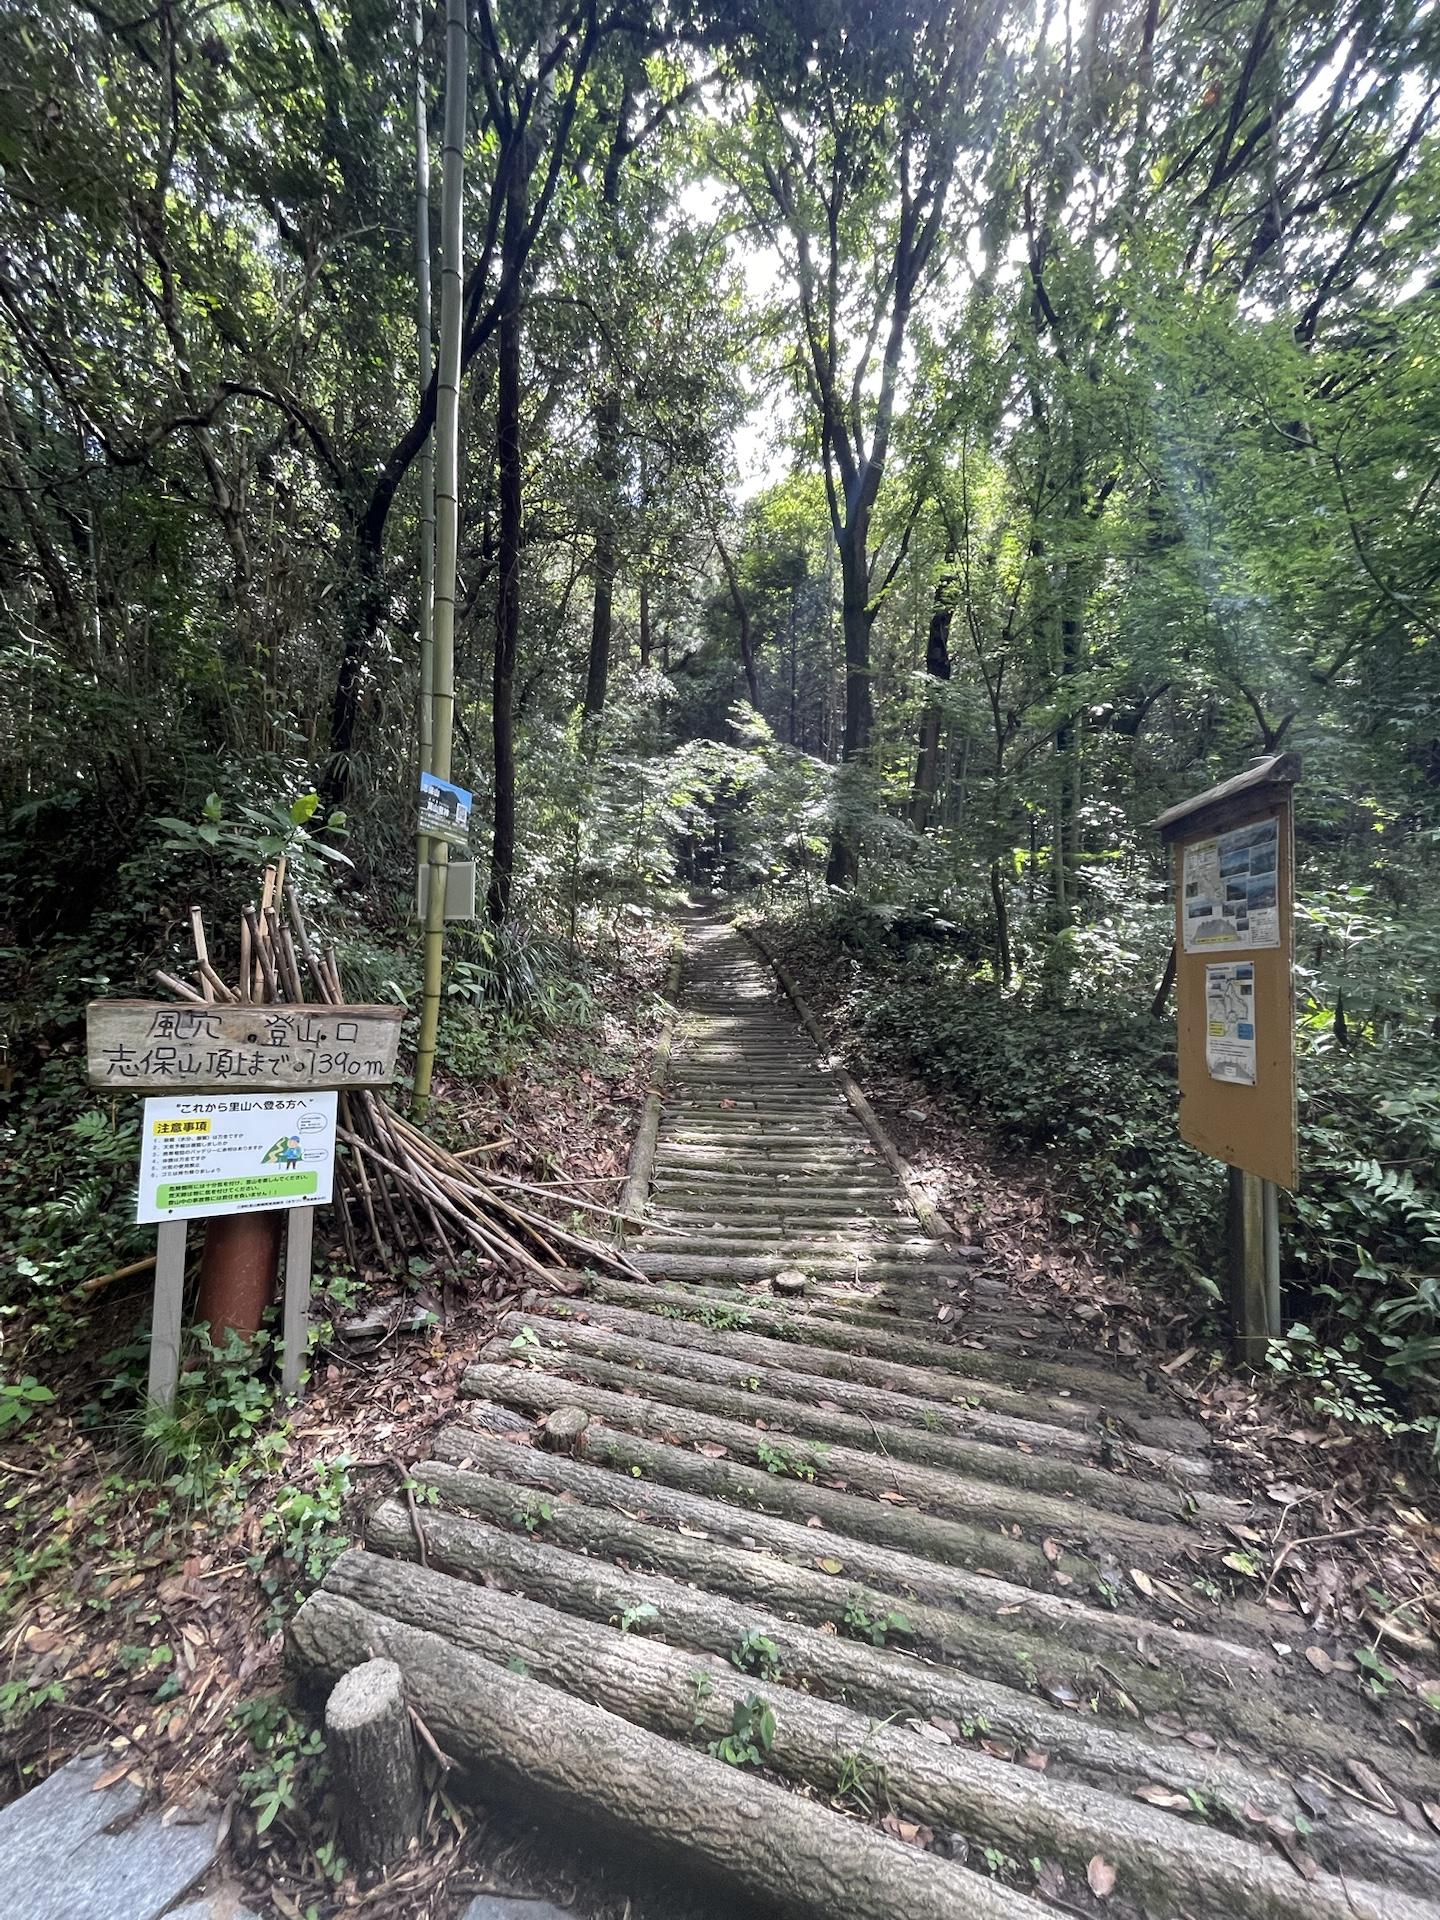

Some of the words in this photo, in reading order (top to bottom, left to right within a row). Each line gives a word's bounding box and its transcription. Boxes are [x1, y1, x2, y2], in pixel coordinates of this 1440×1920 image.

[146, 1011, 222, 1040] 風穴
[157, 1121, 207, 1134] 注意事項
